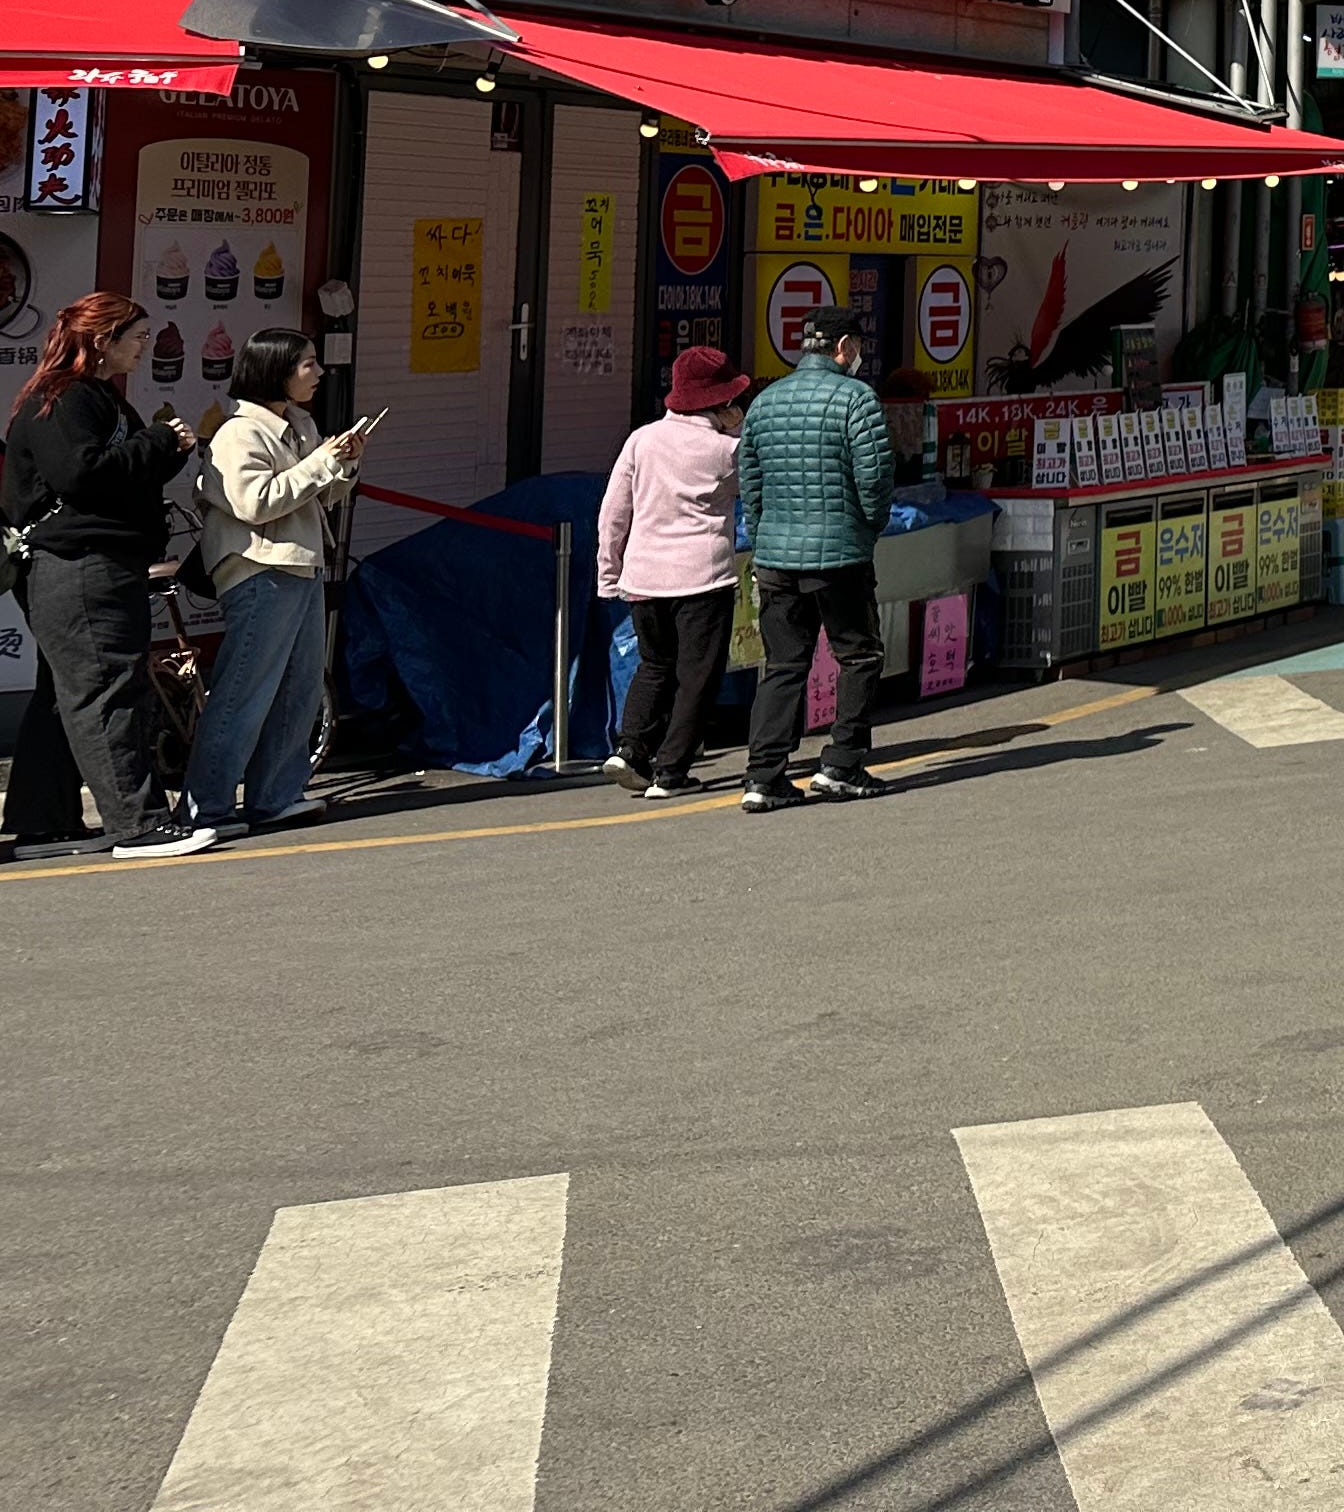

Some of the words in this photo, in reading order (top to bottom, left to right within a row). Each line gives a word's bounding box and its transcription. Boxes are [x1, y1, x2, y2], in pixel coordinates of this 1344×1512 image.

[180, 151, 240, 175] 이탈리아
[243, 154, 273, 177] 정통
[171, 178, 231, 201] 프리미엄
[673, 182, 714, 257] 금
[900, 213, 963, 244] 매입전문
[429, 323, 459, 336] 500
[928, 281, 962, 348] 금
[1221, 513, 1245, 558] 금
[1259, 505, 1298, 546] 은수저
[1115, 530, 1142, 578] 금
[1159, 523, 1205, 566] 은수저
[1214, 559, 1250, 593] 이빨
[1259, 555, 1280, 577] 99%
[1107, 579, 1148, 615] 이빨
[1159, 574, 1182, 600] 99%
[1232, 592, 1256, 615] 삽니다
[1128, 615, 1153, 640] 삽니다
